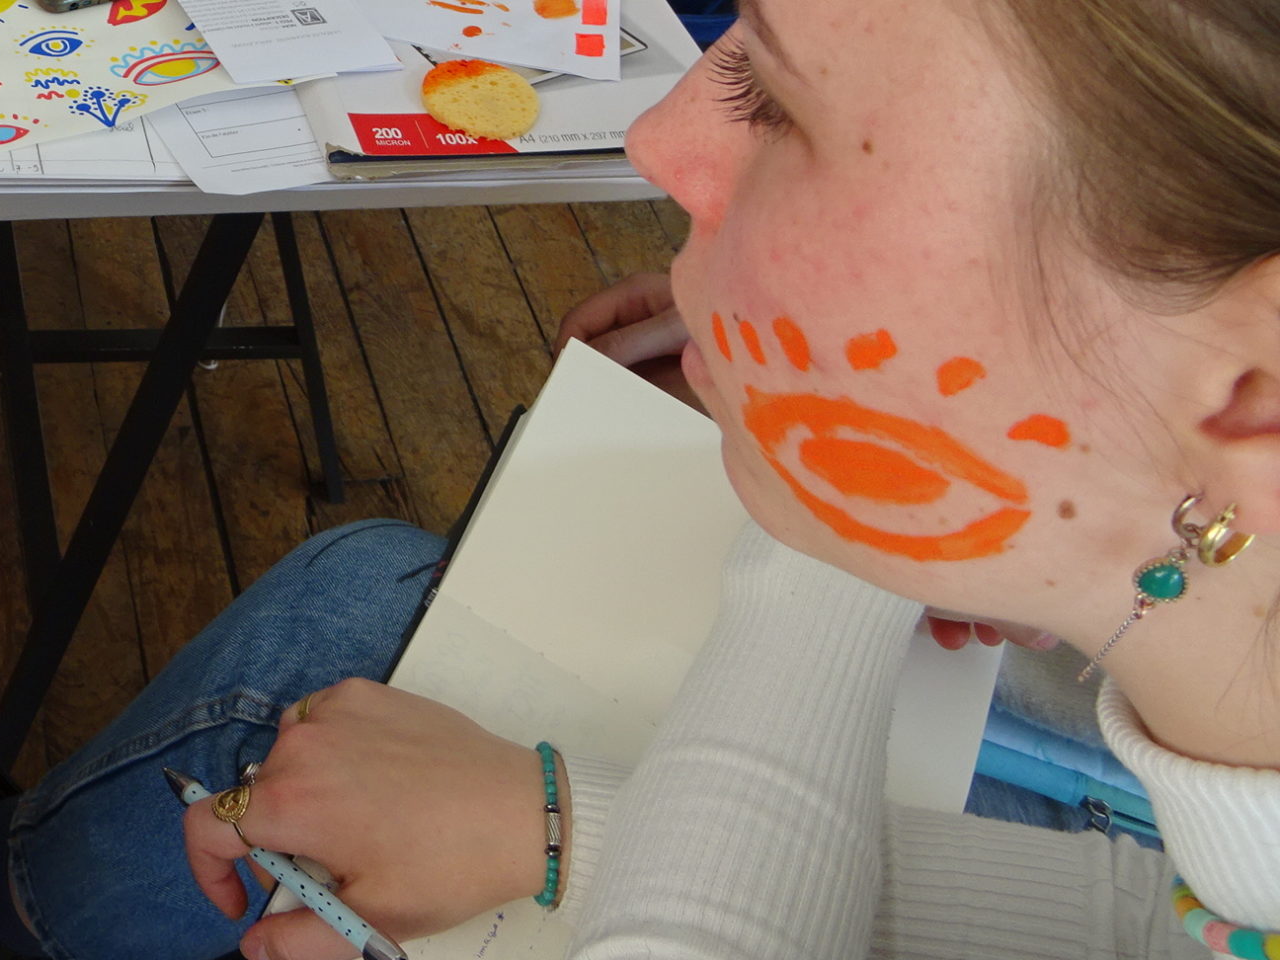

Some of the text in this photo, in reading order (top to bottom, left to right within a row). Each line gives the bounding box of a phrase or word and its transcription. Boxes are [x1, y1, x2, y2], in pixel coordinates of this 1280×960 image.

[372, 127, 402, 139] 200
[520, 134, 535, 144] A4
[561, 132, 580, 142] mm
[590, 131, 608, 140] 297
